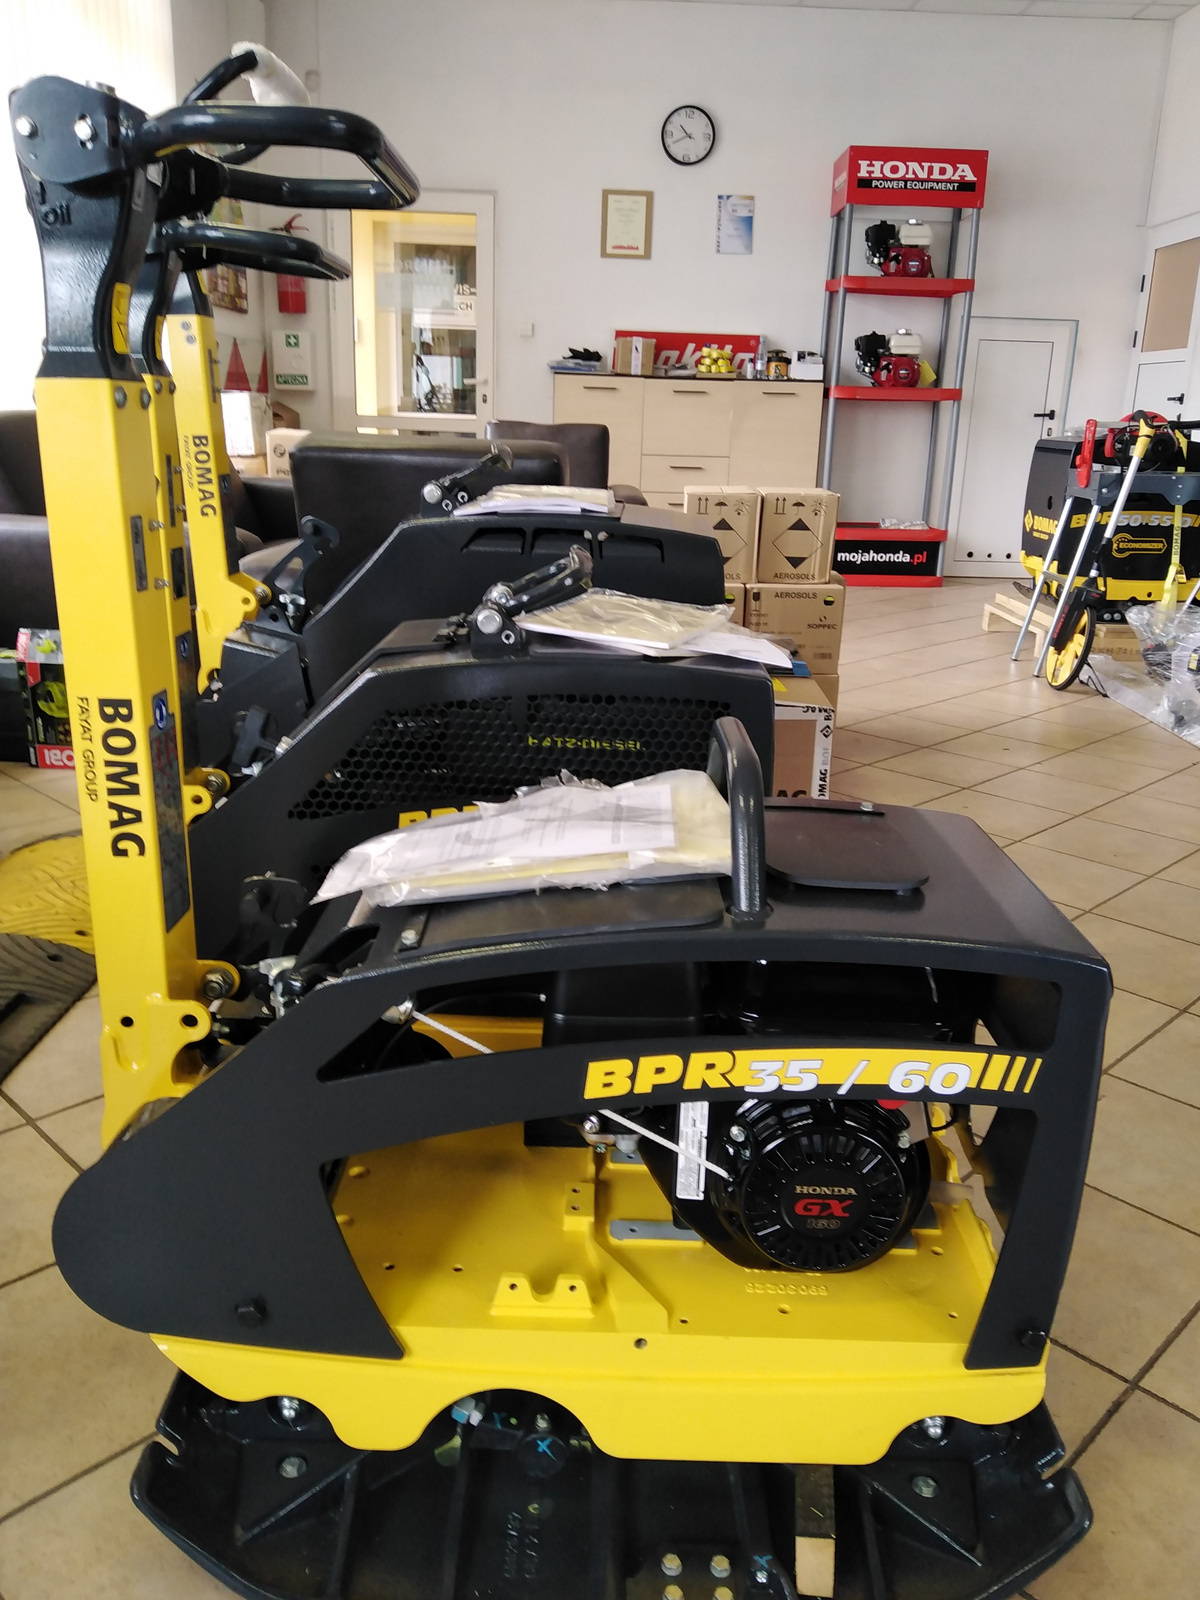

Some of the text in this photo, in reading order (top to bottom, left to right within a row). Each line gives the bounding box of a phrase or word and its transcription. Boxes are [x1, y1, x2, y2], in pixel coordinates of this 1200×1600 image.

[685, 109, 695, 119] 12
[857, 160, 977, 181] HONDA
[872, 180, 960, 191] POWER EQUIPMENT
[192, 434, 217, 517] BOMAG
[1173, 526, 1181, 556] BOMAG
[837, 550, 927, 565] mojahonda.pl
[773, 572, 816, 581] AEROSOLS
[44, 748, 75, 766] OBI
[77, 696, 98, 802] FAYAT GROUP
[97, 698, 146, 858] BOMAG
[584, 1051, 735, 1100] BPR
[744, 1060, 824, 1093] 35
[888, 1061, 972, 1095] 60
[795, 1185, 858, 1196] HONDA
[794, 1198, 854, 1217] GX
